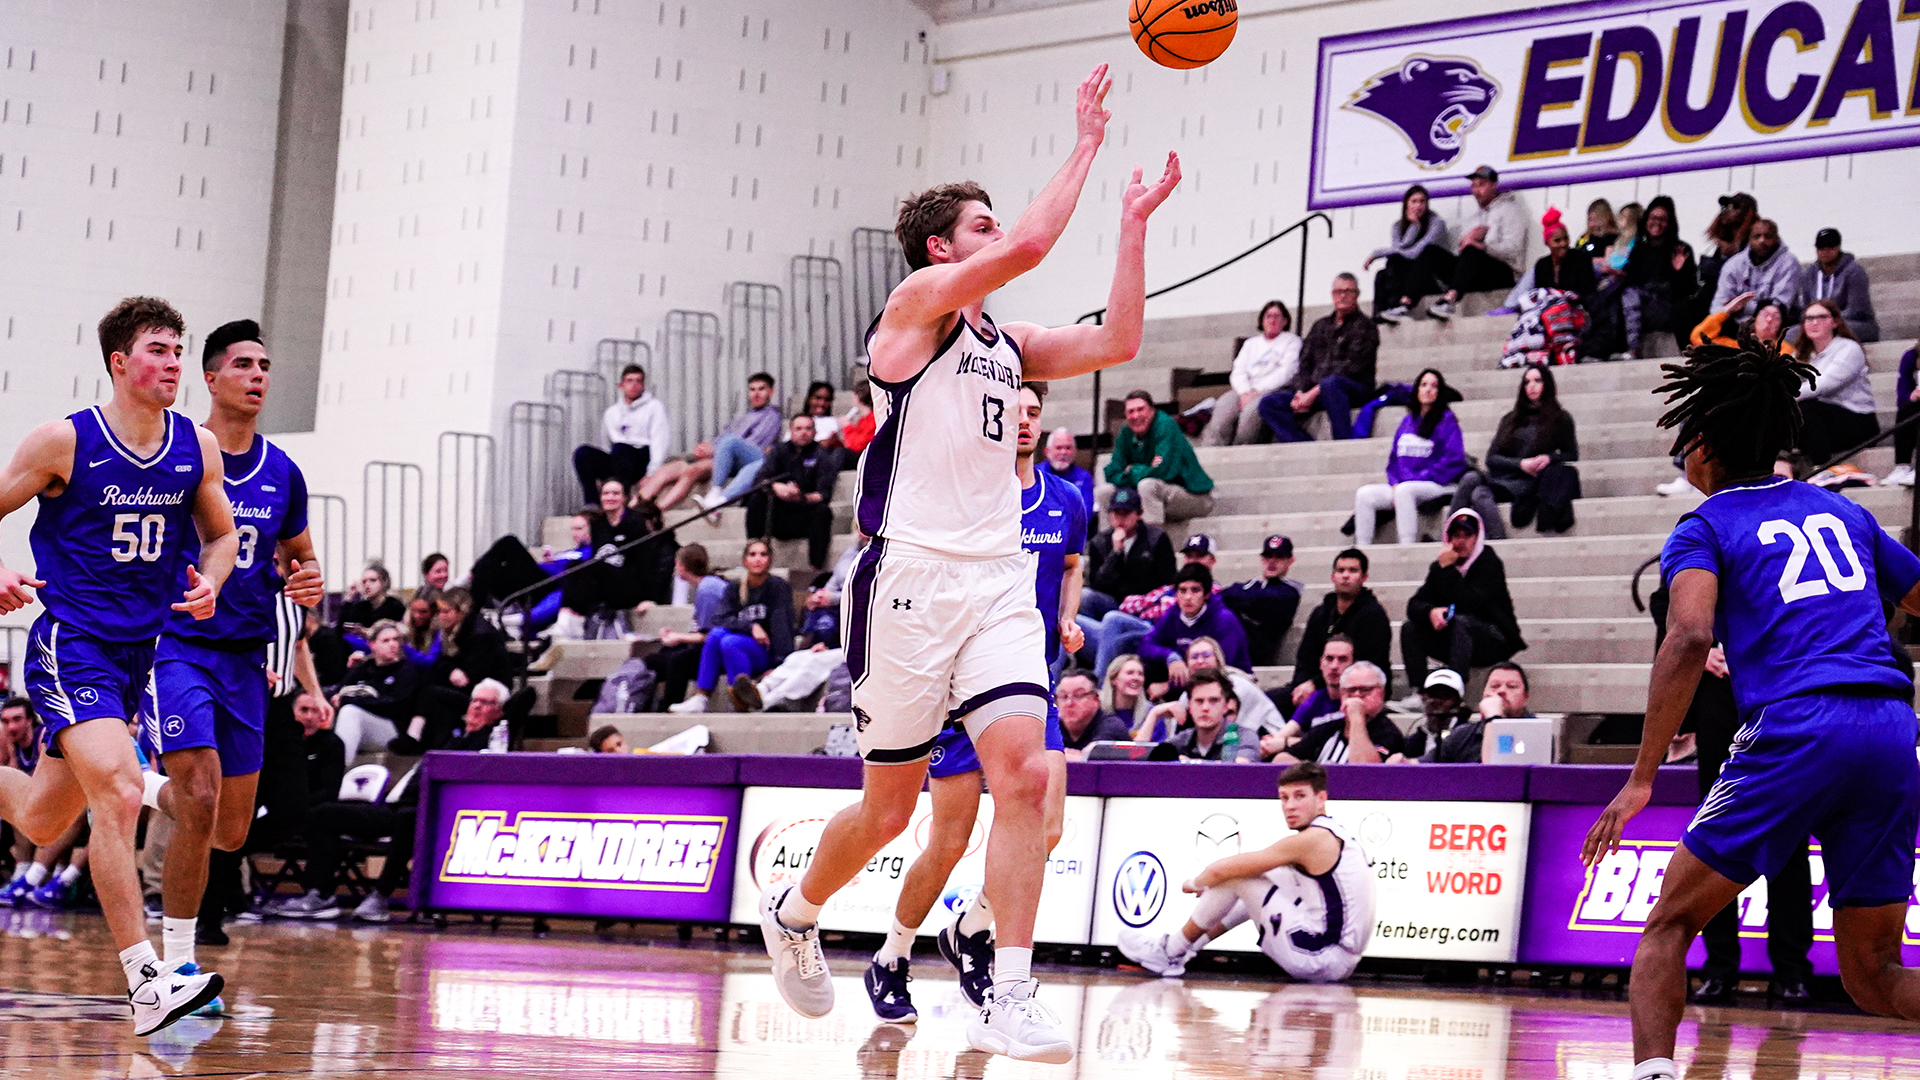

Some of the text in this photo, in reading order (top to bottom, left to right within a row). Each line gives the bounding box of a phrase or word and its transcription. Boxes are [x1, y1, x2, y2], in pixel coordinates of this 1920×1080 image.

[982, 393, 1005, 442] 13
[99, 484, 184, 506] Rockhurst
[111, 513, 166, 562] 50
[235, 524, 258, 569] 3
[1021, 527, 1063, 544] khurst
[1757, 512, 1867, 604] 20
[446, 817, 721, 884] McKENDREE
[1428, 823, 1507, 852] BERG
[1426, 871, 1502, 895] WORD
[1375, 919, 1500, 945] fenberg.com
